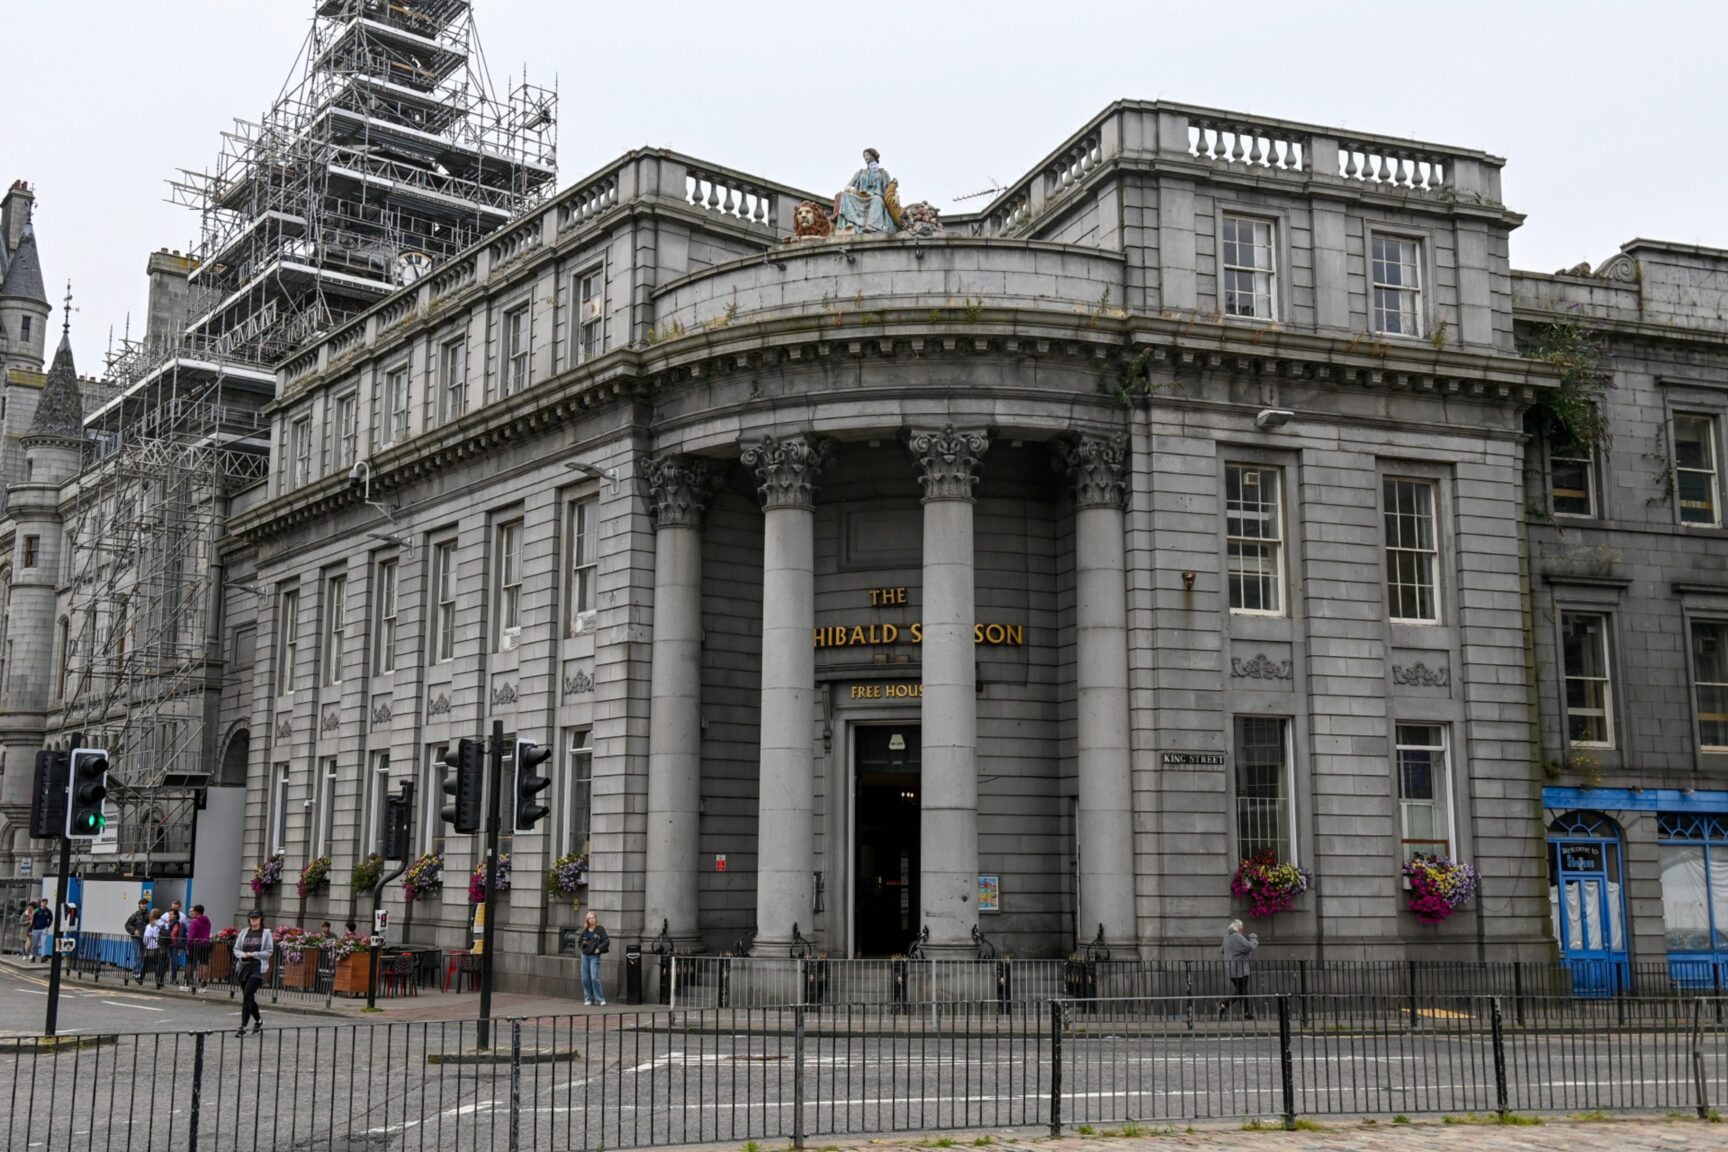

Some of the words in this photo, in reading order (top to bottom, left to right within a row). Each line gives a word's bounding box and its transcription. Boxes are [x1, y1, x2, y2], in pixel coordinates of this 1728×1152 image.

[869, 587, 907, 605] THE
[813, 623, 897, 646] HIBALD
[911, 623, 1023, 645] SSON
[851, 685, 881, 699] FREE
[886, 684, 924, 698] HOUS
[1164, 754, 1186, 763] KING
[1189, 755, 1224, 764] STREET
[1562, 846, 1590, 854] Welcome
